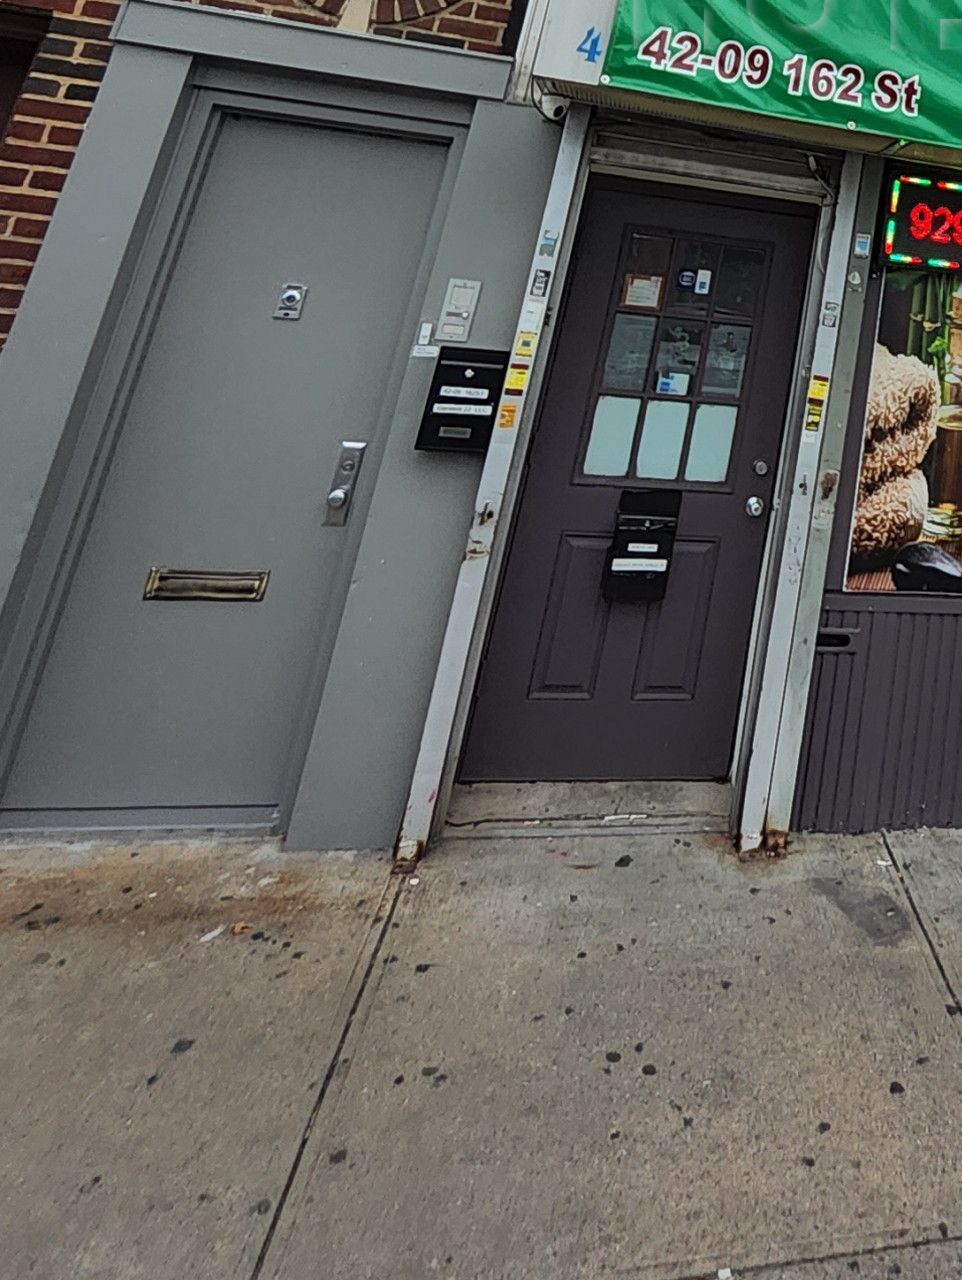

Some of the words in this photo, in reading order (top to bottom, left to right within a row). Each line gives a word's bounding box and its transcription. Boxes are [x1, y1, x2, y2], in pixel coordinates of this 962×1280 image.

[637, 26, 773, 90] 42-09
[783, 53, 864, 108] 162
[871, 70, 921, 117] St
